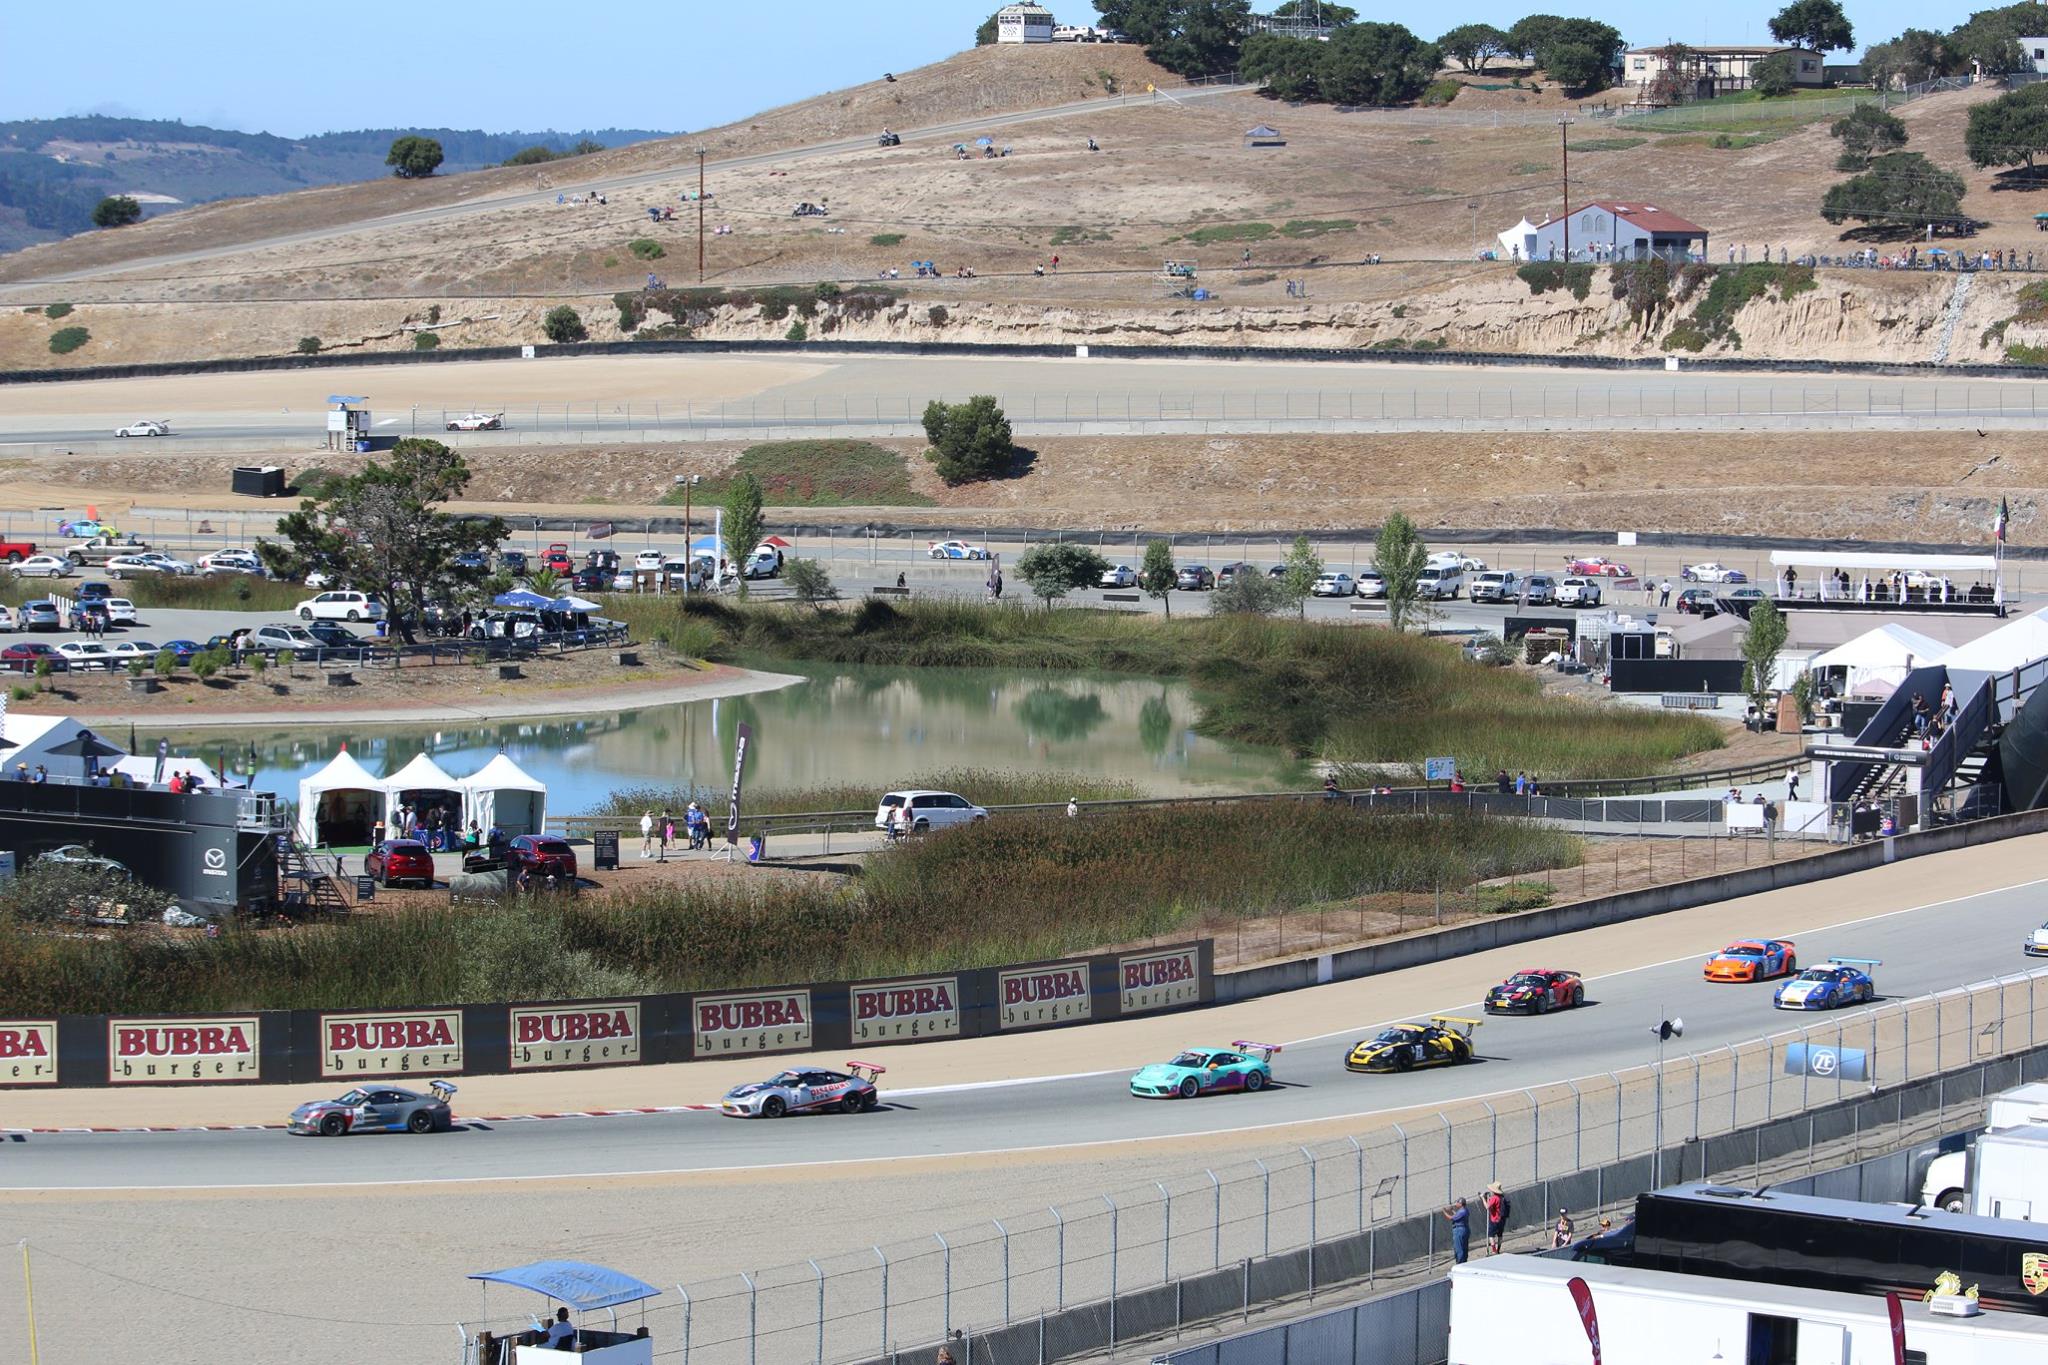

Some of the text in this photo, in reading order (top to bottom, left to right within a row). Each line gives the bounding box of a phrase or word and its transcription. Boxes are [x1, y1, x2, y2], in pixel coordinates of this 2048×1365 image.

[1124, 955, 1195, 989] BUBBA
[1004, 970, 1086, 1004] BUBBA
[1128, 986, 1192, 1007] burger
[700, 998, 804, 1032] BUBBA
[857, 985, 953, 1019] BUBBA
[1009, 1001, 1083, 1023] burger
[329, 1019, 455, 1051] BUBBA
[517, 1010, 633, 1043] BUBBA
[862, 1018, 951, 1038] burger
[118, 1026, 251, 1056] BUBBA
[523, 1044, 628, 1062] burger
[705, 1031, 801, 1051] burger
[124, 1059, 245, 1078] burger
[335, 1053, 450, 1071] burger
